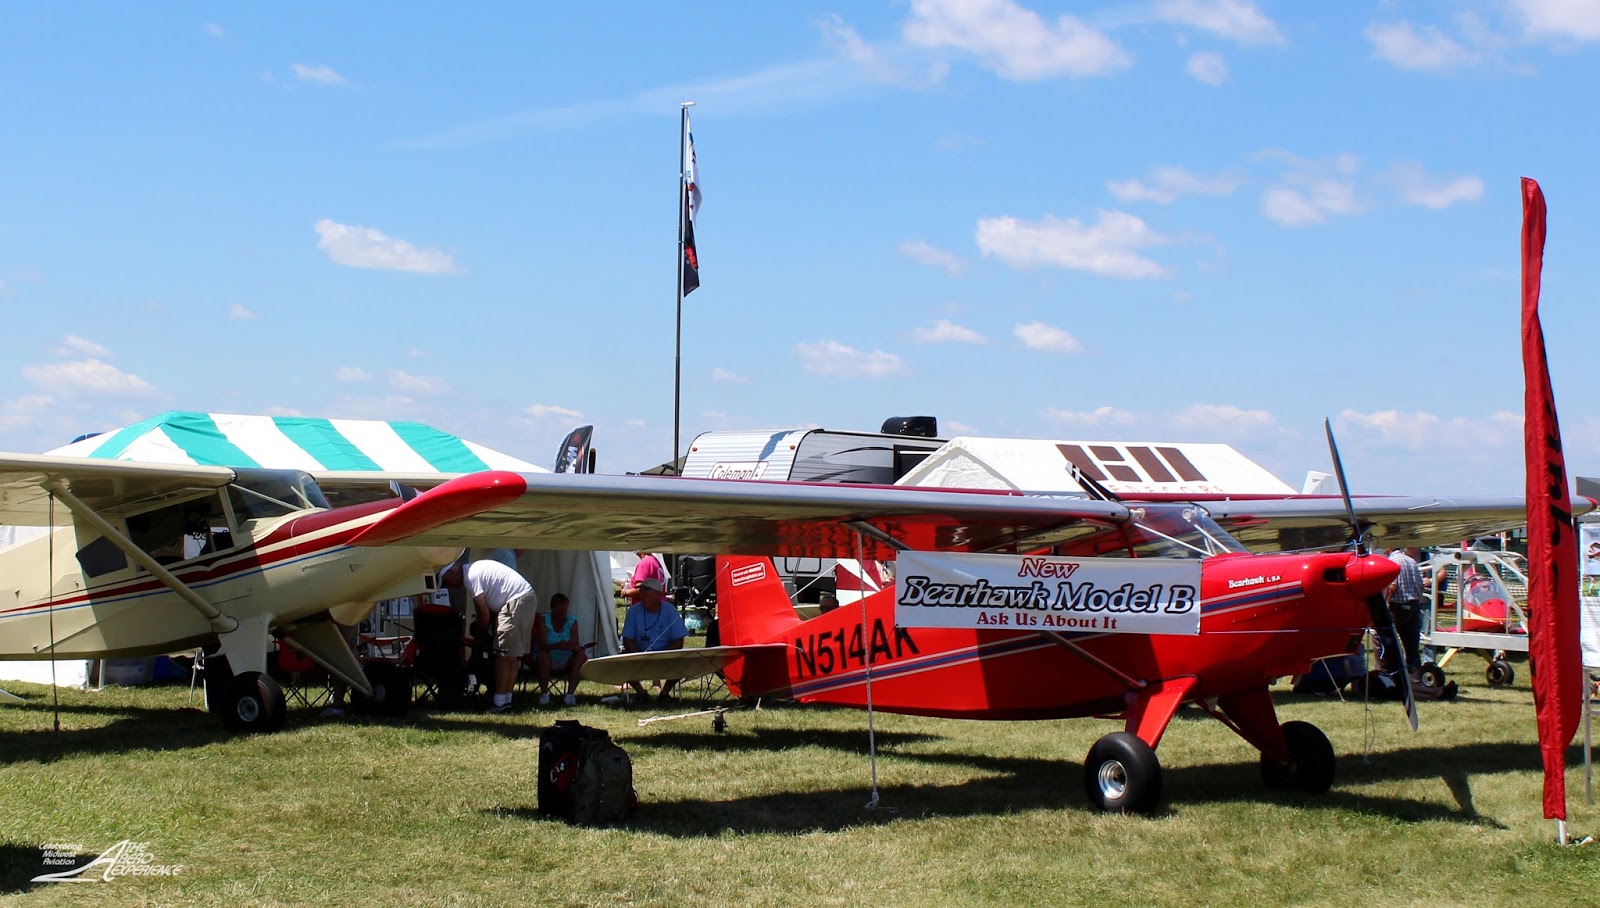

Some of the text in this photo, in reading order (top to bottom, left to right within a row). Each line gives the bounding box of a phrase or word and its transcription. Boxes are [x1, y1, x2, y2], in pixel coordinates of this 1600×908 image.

[712, 465, 753, 480] Coleman
[1018, 558, 1078, 579] New
[1228, 575, 1265, 589] Bearhawk
[899, 576, 1196, 614] Bearhawk Model B
[976, 610, 1118, 630] Ask Us About It
[795, 617, 920, 680] N514AK
